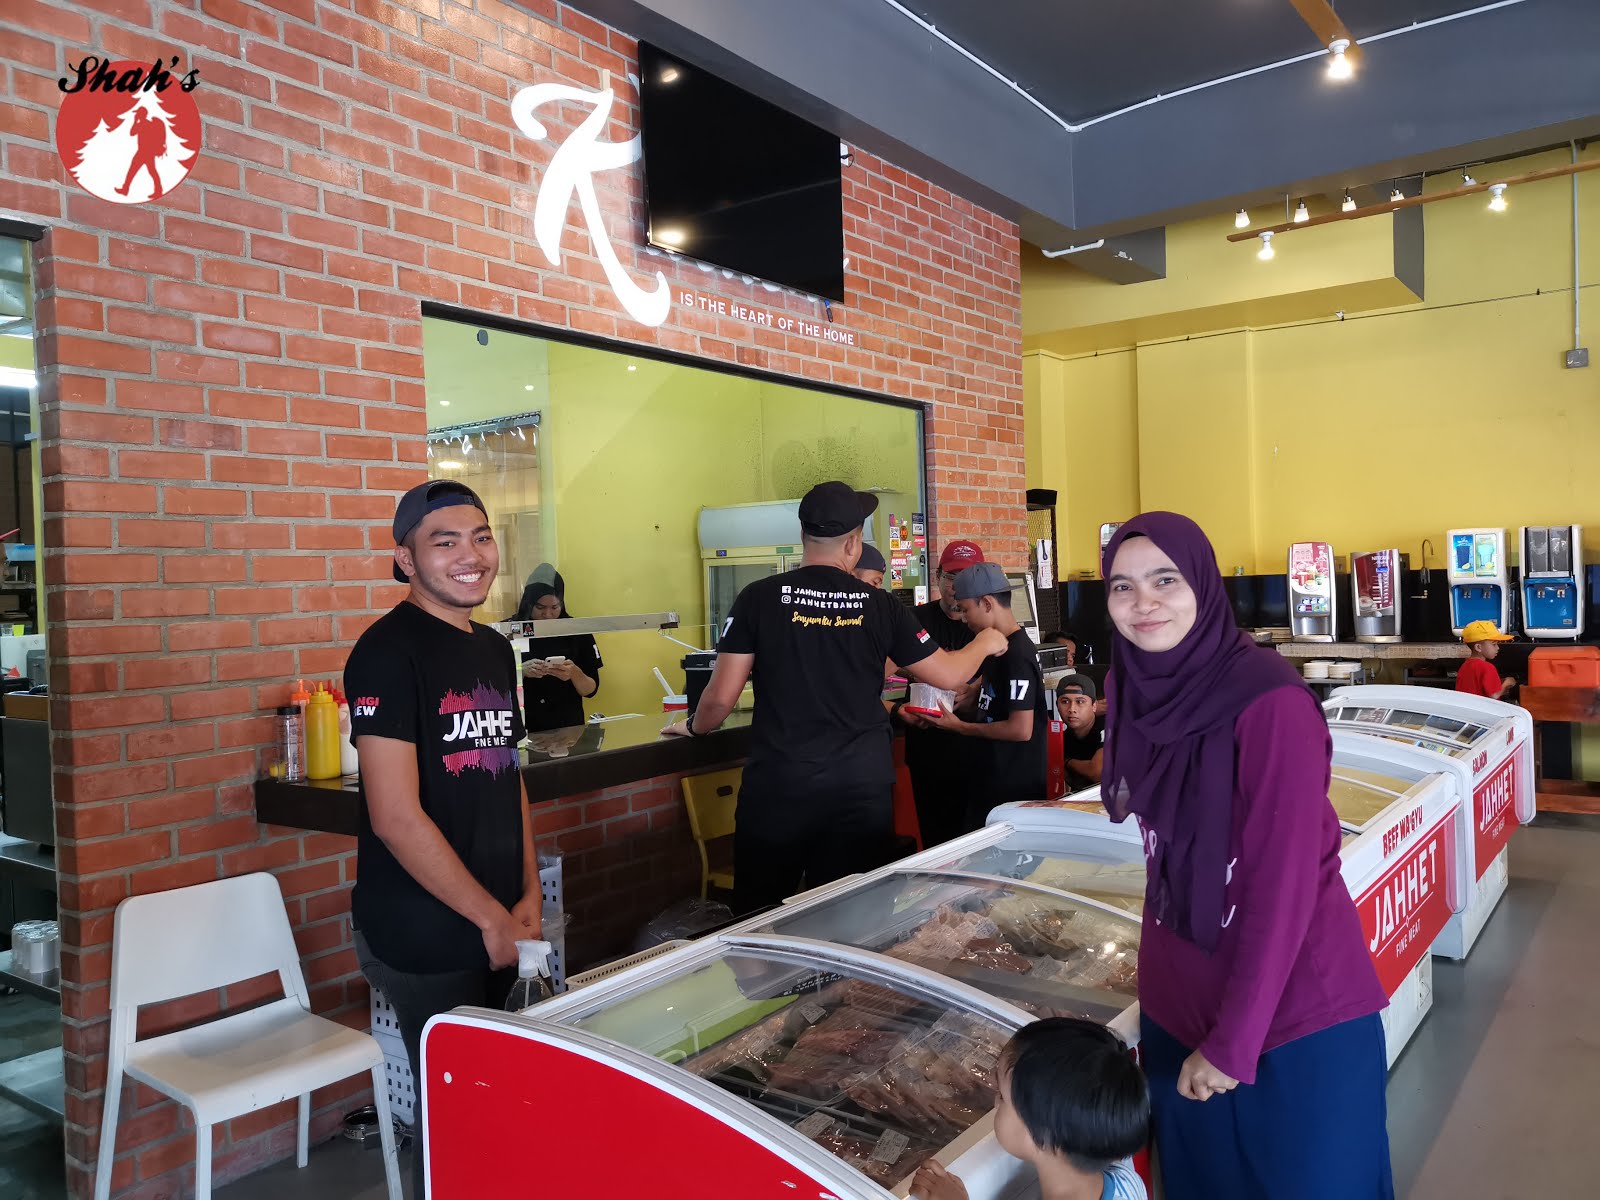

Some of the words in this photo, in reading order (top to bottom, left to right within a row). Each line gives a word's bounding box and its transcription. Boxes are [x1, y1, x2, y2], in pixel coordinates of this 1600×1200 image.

[680, 291, 694, 306] IS
[698, 297, 726, 315] THE
[730, 306, 774, 327] HEART
[777, 317, 794, 331] OF
[798, 321, 820, 337] THE
[823, 328, 854, 345] HOME
[1009, 679, 1030, 701] 17
[1480, 762, 1514, 832] JAHHET
[1382, 823, 1399, 859] BEEF
[1369, 838, 1437, 953] JAHHET
[1396, 933, 1408, 958] FINE
[1408, 918, 1421, 943] MEAT
